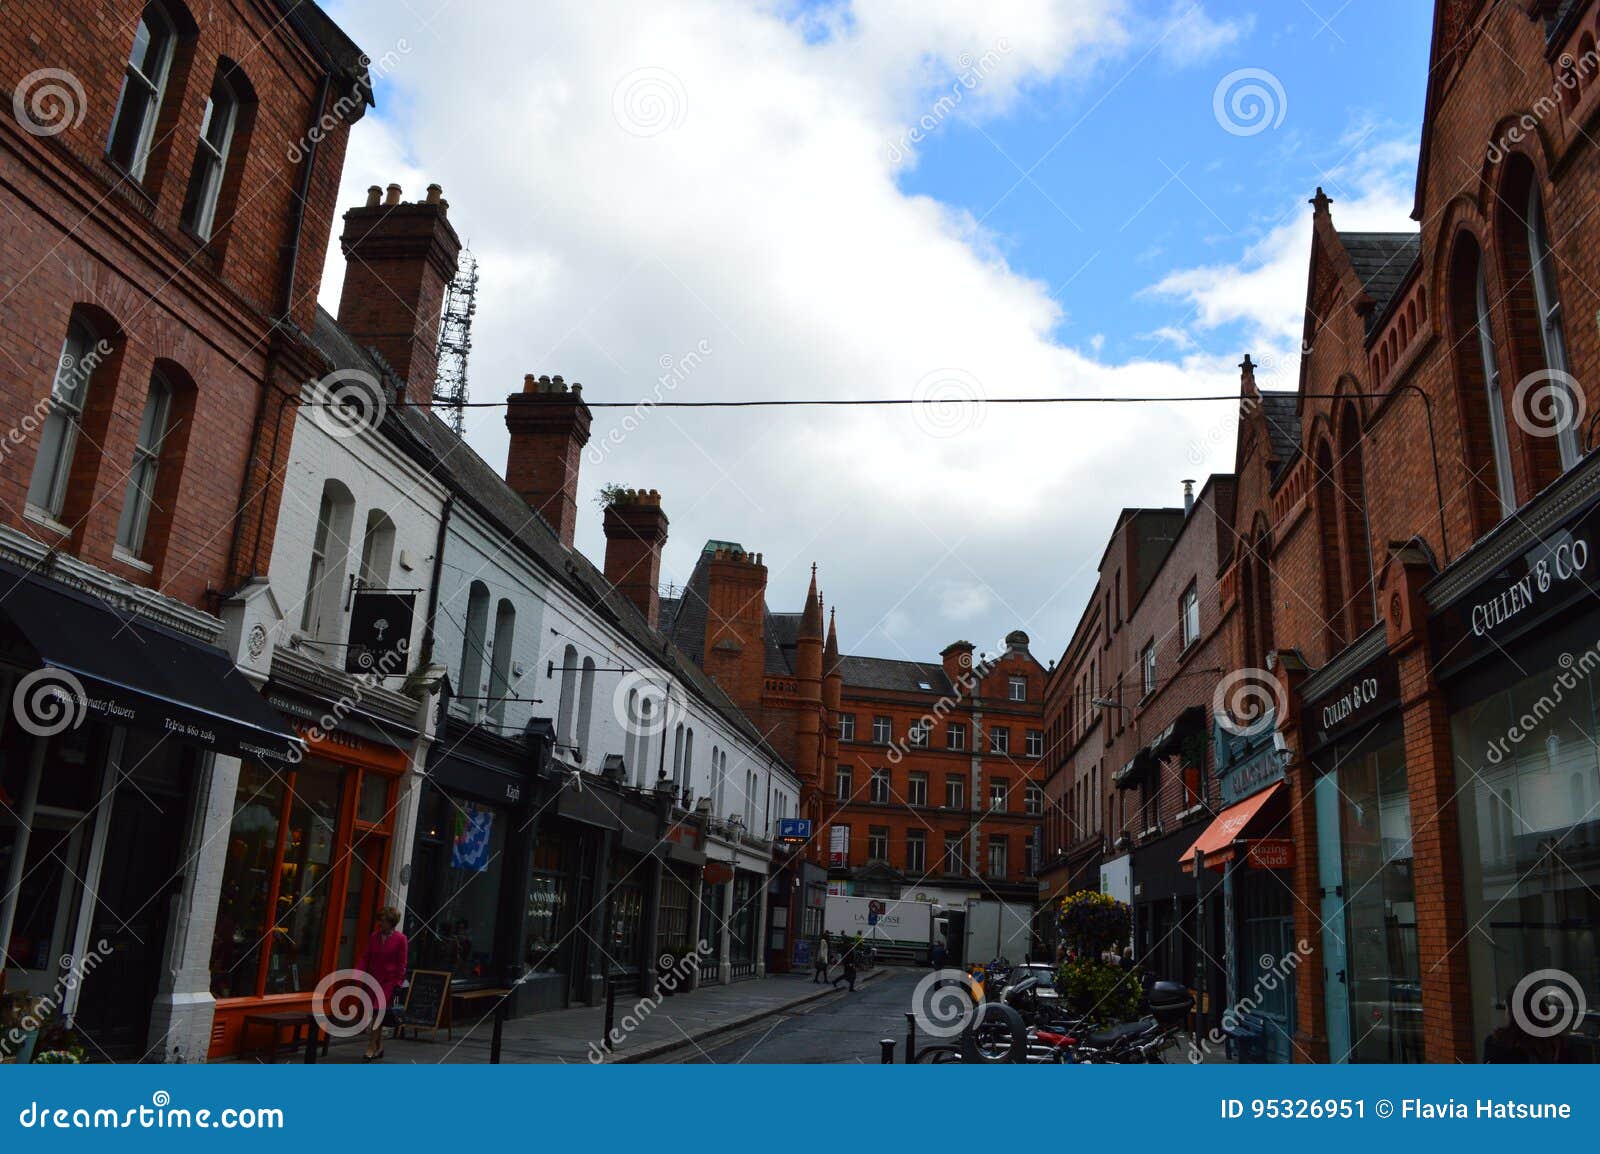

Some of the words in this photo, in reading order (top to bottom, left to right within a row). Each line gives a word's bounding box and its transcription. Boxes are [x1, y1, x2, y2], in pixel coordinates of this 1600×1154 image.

[1471, 575, 1535, 637] CULLEN
[1536, 559, 1551, 593] &
[1555, 539, 1588, 581] CO
[104, 699, 136, 719] flowers
[1322, 696, 1353, 729] CULLEN
[1352, 685, 1361, 710] &
[1361, 677, 1379, 704] CO
[798, 822, 805, 834] P
